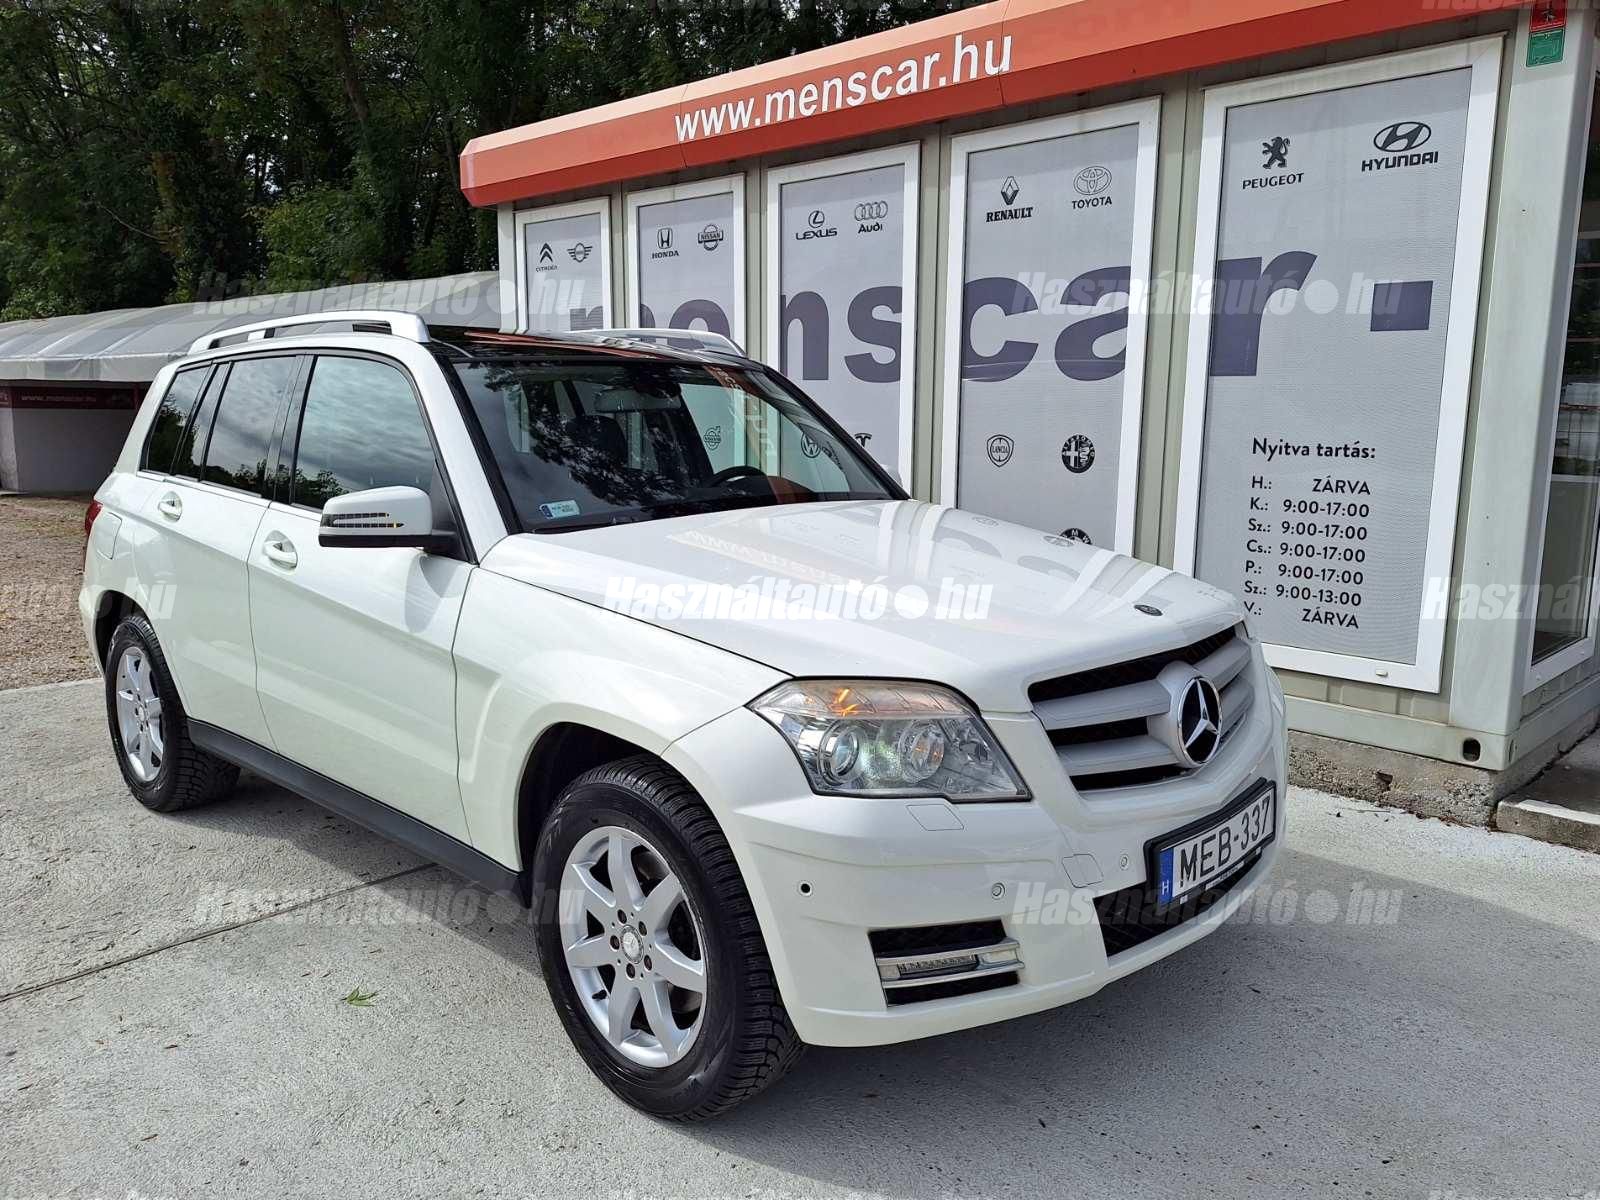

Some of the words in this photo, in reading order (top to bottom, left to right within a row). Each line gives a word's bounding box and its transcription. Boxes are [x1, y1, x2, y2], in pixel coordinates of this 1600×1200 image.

[675, 33, 1012, 141] www.menscar.hu
[1361, 151, 1439, 172] HYUNDAI
[1242, 173, 1304, 189] PEUGEOT
[1072, 196, 1113, 209] TOYOTA
[986, 207, 1033, 222] RENAULT
[796, 228, 837, 240] LEXUS
[858, 223, 883, 233] Audi
[652, 250, 680, 259] HONDA
[1252, 437, 1310, 462] Nyitva
[1316, 440, 1376, 458] tartás:
[1251, 476, 1272, 489] H.:
[1312, 475, 1371, 495] ZÁRVA
[1250, 497, 1269, 511] K.:
[1283, 499, 1370, 518] 9:00-17:00
[1248, 518, 1271, 532] Sz.:
[1281, 521, 1367, 540] 9:00-17:00
[1246, 539, 1271, 554] Cs.:
[1280, 542, 1366, 563] 9:00-17:00
[1245, 560, 1262, 574] P.:
[1278, 564, 1363, 585] 9:00-17:00
[1244, 581, 1267, 595] Sz.:
[1276, 584, 1361, 607] 9:00-13:00
[1244, 601, 1263, 616] V.:
[1301, 606, 1359, 629] ZÁRVA
[1180, 795, 1271, 882] MEB-337
[1161, 880, 1169, 896] H
